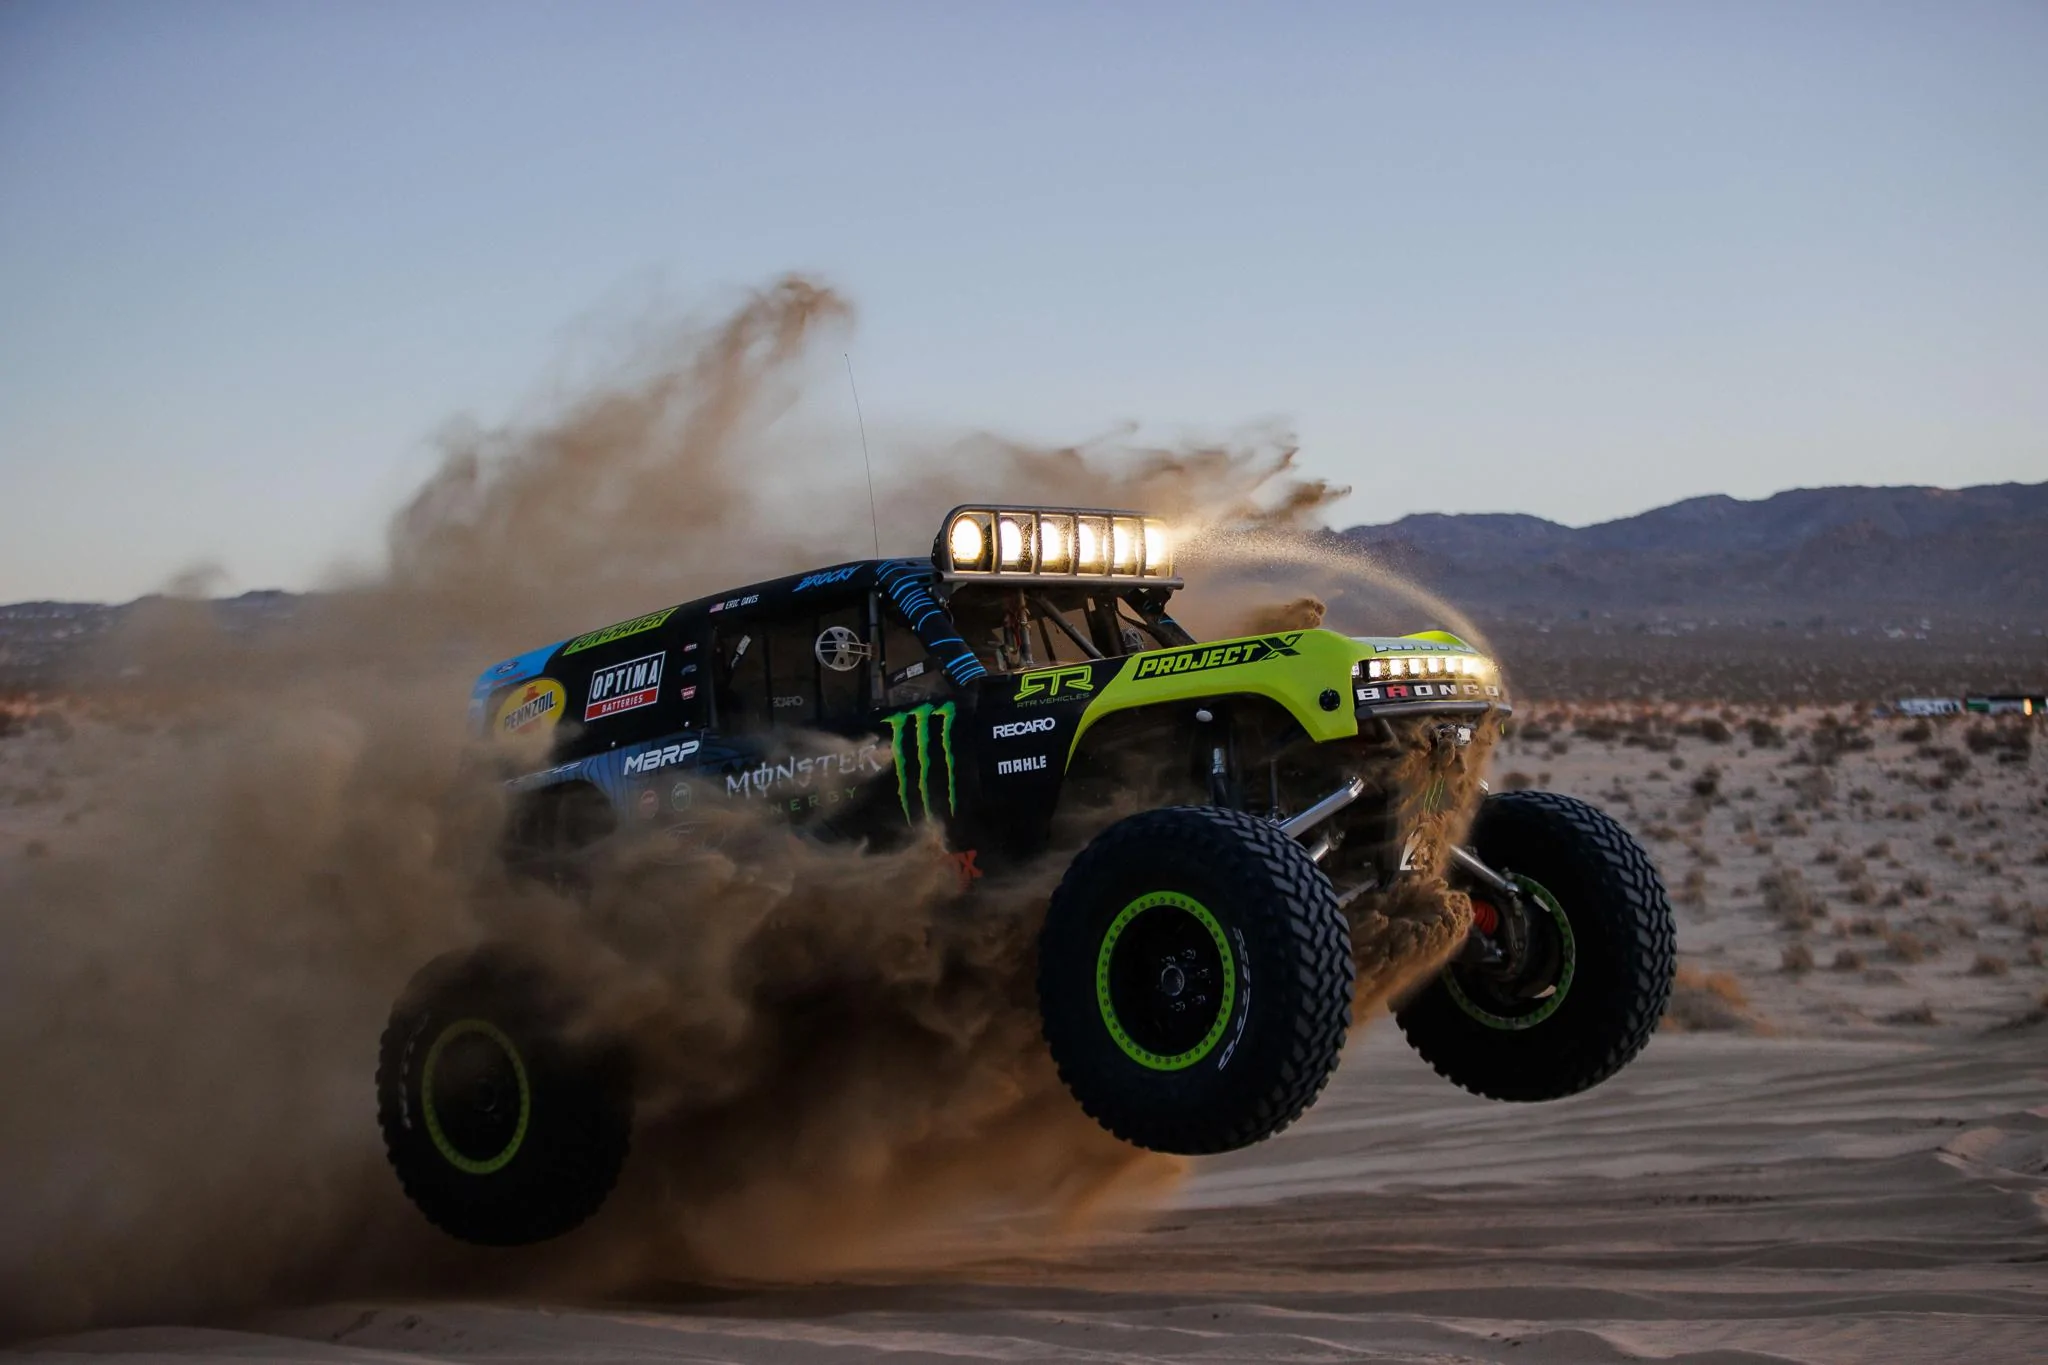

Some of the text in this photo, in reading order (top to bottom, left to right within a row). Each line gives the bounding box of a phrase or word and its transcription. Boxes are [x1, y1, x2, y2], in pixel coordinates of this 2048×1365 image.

[1138, 643, 1261, 677] PROJECT
[592, 658, 659, 700] OPTIMA
[1356, 684, 1499, 700] BRONCO
[504, 691, 557, 731] PENNZOIL
[602, 695, 643, 713] BATTERIES
[1016, 693, 1090, 709] RTR VEHICLES
[993, 717, 1056, 739] RECARO
[624, 740, 699, 776] MBRP
[725, 744, 882, 799] MONSTER
[998, 755, 1047, 775] MAHLE
[769, 786, 857, 816] NERGY
